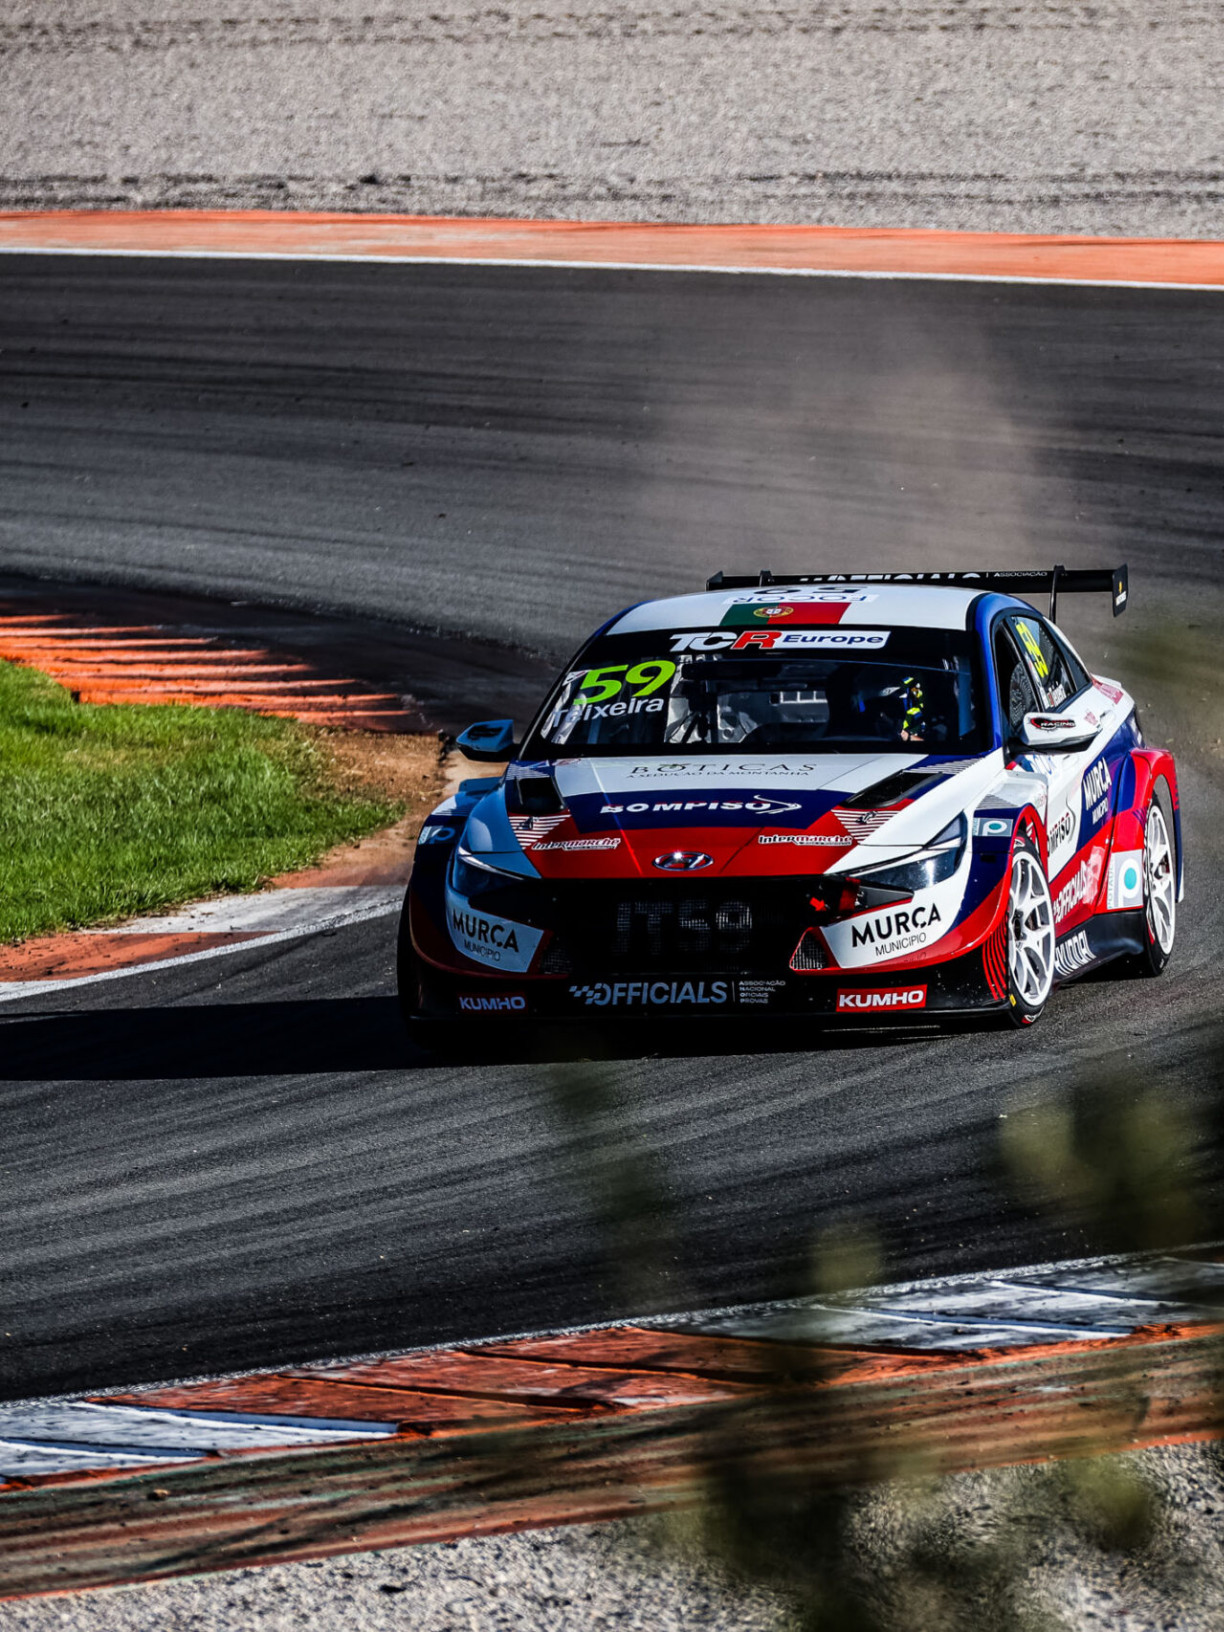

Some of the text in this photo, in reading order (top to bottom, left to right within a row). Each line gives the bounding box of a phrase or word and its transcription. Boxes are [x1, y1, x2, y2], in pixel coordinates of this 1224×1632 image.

[669, 630, 884, 652] TCR Europe
[573, 660, 676, 706] 59
[600, 800, 771, 814] BOMPISO
[459, 996, 526, 1010] KUMHO
[593, 980, 728, 1006] OFFICIALS
[839, 989, 925, 1009] KUMHO
